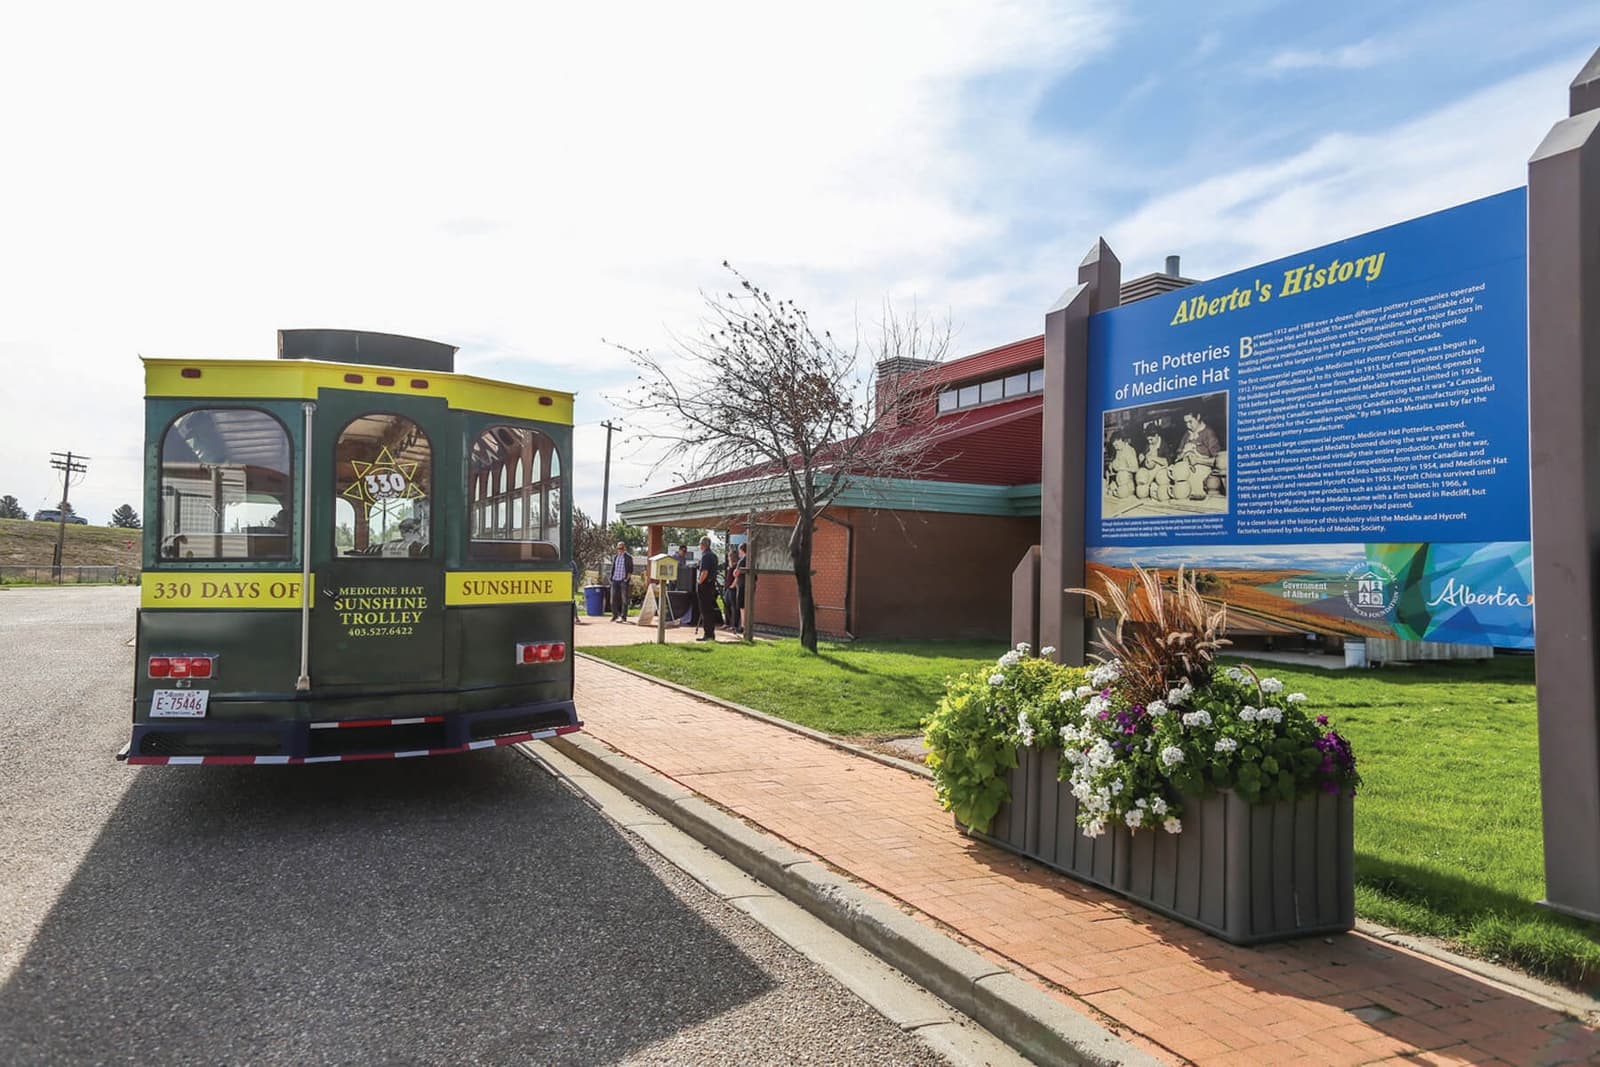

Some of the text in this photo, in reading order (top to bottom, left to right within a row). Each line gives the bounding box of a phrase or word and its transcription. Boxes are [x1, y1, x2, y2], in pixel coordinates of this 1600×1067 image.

[1170, 252, 1386, 326] Alberta's History
[1450, 283, 1485, 298] operated
[1459, 296, 1473, 306] clay
[1447, 306, 1473, 316] factors
[1442, 317, 1466, 328] period
[1443, 340, 1467, 350] begun
[1445, 347, 1484, 360] purchased
[1133, 345, 1230, 377] The Potteries
[1443, 359, 1472, 370] opened
[1115, 366, 1230, 401] of Medicine Hat
[1456, 375, 1492, 386] Canadian
[1471, 385, 1494, 393] useful
[1450, 399, 1460, 407] by
[1455, 458, 1491, 466] Medicine
[1443, 469, 1475, 477] survived
[364, 473, 406, 494] 330
[153, 582, 301, 599] 330 DAYS OF
[339, 586, 425, 596] MEDICINE HAT
[462, 580, 553, 596] SUNSHINE
[1282, 581, 1327, 590] Government
[1282, 590, 1320, 599] of Alberta
[1426, 578, 1533, 607] Alberta
[334, 597, 428, 611] SUNSHINE
[339, 611, 423, 625] TROLLEY
[348, 626, 413, 637] 403.527.6422
[156, 697, 202, 711] E-75446
